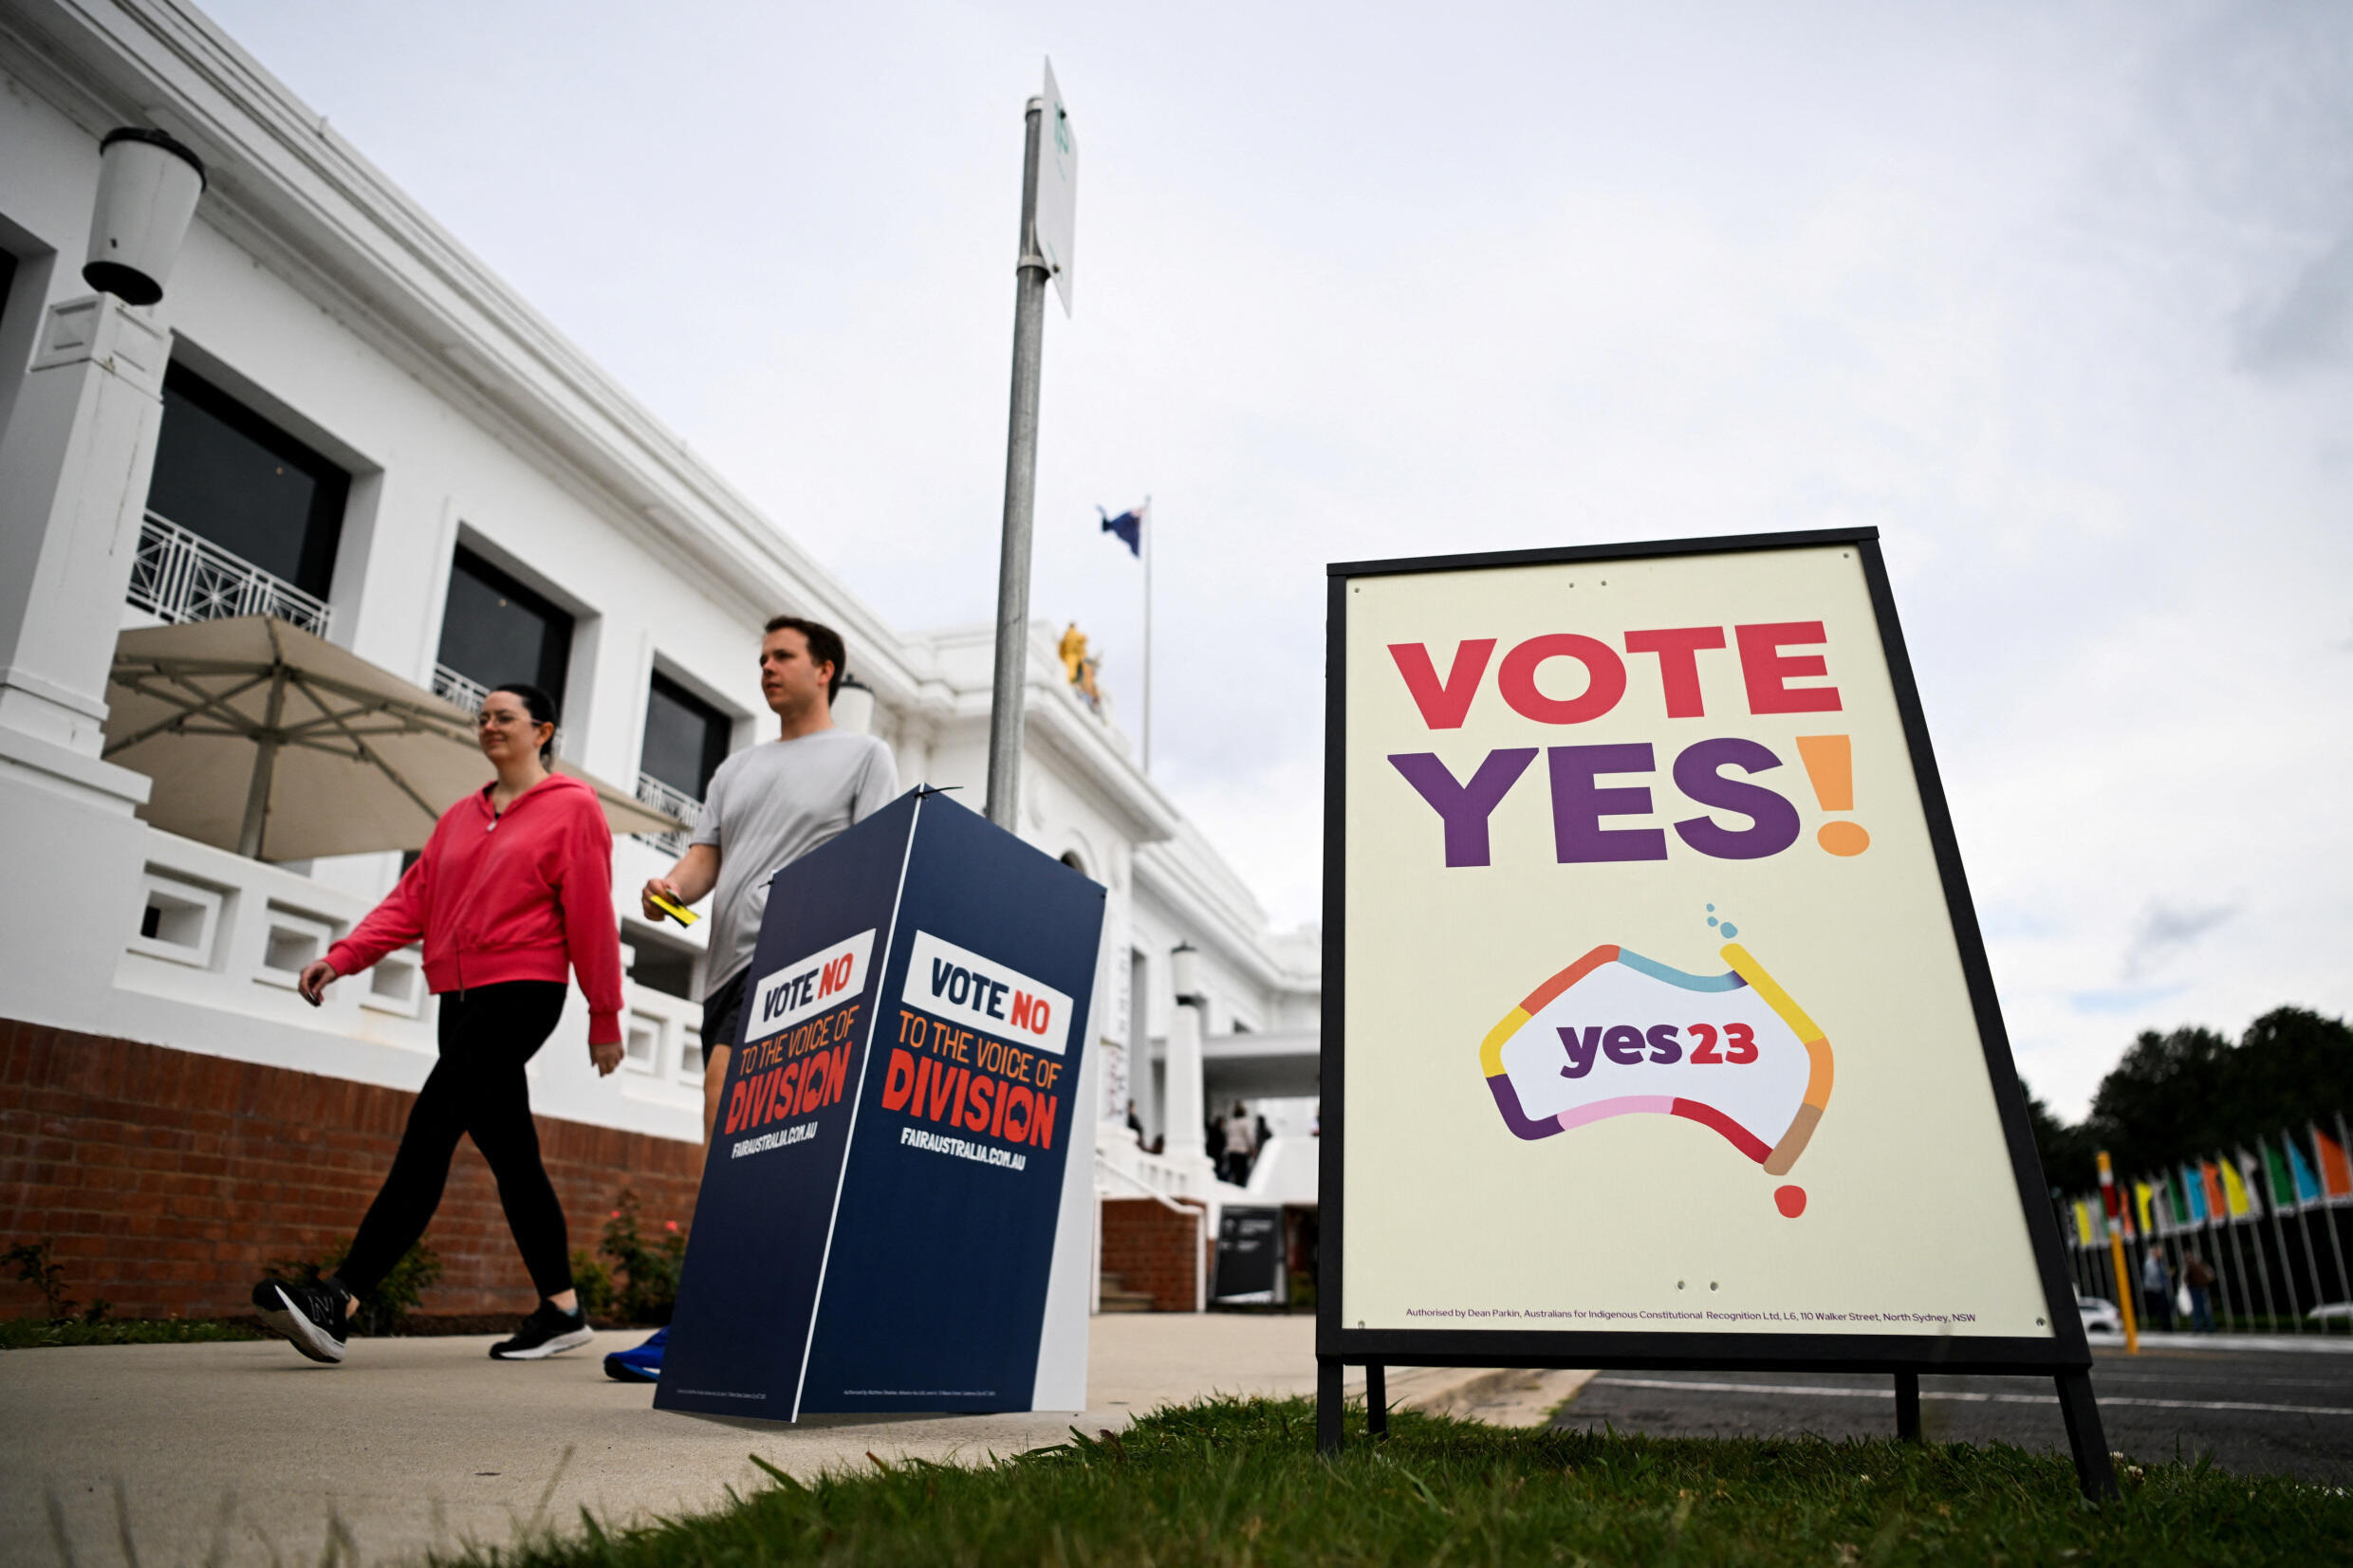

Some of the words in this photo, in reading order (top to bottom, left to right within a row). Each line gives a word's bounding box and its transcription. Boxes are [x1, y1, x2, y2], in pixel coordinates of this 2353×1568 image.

[1386, 620, 1843, 729] VOTE
[1386, 734, 1870, 868] YES!
[763, 968, 820, 1023] VOTE
[817, 952, 854, 1000] NO
[931, 957, 1010, 1020] VOTE
[1010, 989, 1050, 1035] NO
[741, 1046, 758, 1075] TO
[759, 1035, 787, 1067] THE
[788, 1014, 833, 1056] VOICE
[833, 1005, 861, 1042] OF
[899, 1010, 927, 1048] TO
[933, 1022, 973, 1063] THE
[977, 1041, 1033, 1082] VOICE
[1035, 1059, 1063, 1090] OF
[724, 1041, 853, 1135] DIVISION
[881, 1048, 1058, 1150] DIVISION
[732, 1121, 819, 1159] FAIRAUSTRALIA.COM.AU
[900, 1127, 1026, 1171] FAIRAUSTRALIA.COM.AU
[1405, 1308, 1454, 1318] Authorised
[1454, 1308, 1466, 1319] by
[1468, 1308, 1491, 1318] Dean
[1492, 1308, 1523, 1319] Parkin,
[1524, 1308, 1572, 1319] Australians
[1573, 1309, 1587, 1319] for
[1588, 1309, 1639, 1320] Indigenous
[1640, 1310, 1703, 1319] Constitutional
[1706, 1311, 1762, 1322] Recognition
[1763, 1311, 1783, 1321] Ltd,
[1784, 1311, 1799, 1321] L6,
[1800, 1312, 1814, 1321] 110
[1815, 1312, 1847, 1321] Walker
[1848, 1312, 1882, 1323] Street,
[1883, 1313, 1912, 1322] North
[1912, 1313, 1952, 1325] Sydney,
[1952, 1314, 1976, 1323] NSW
